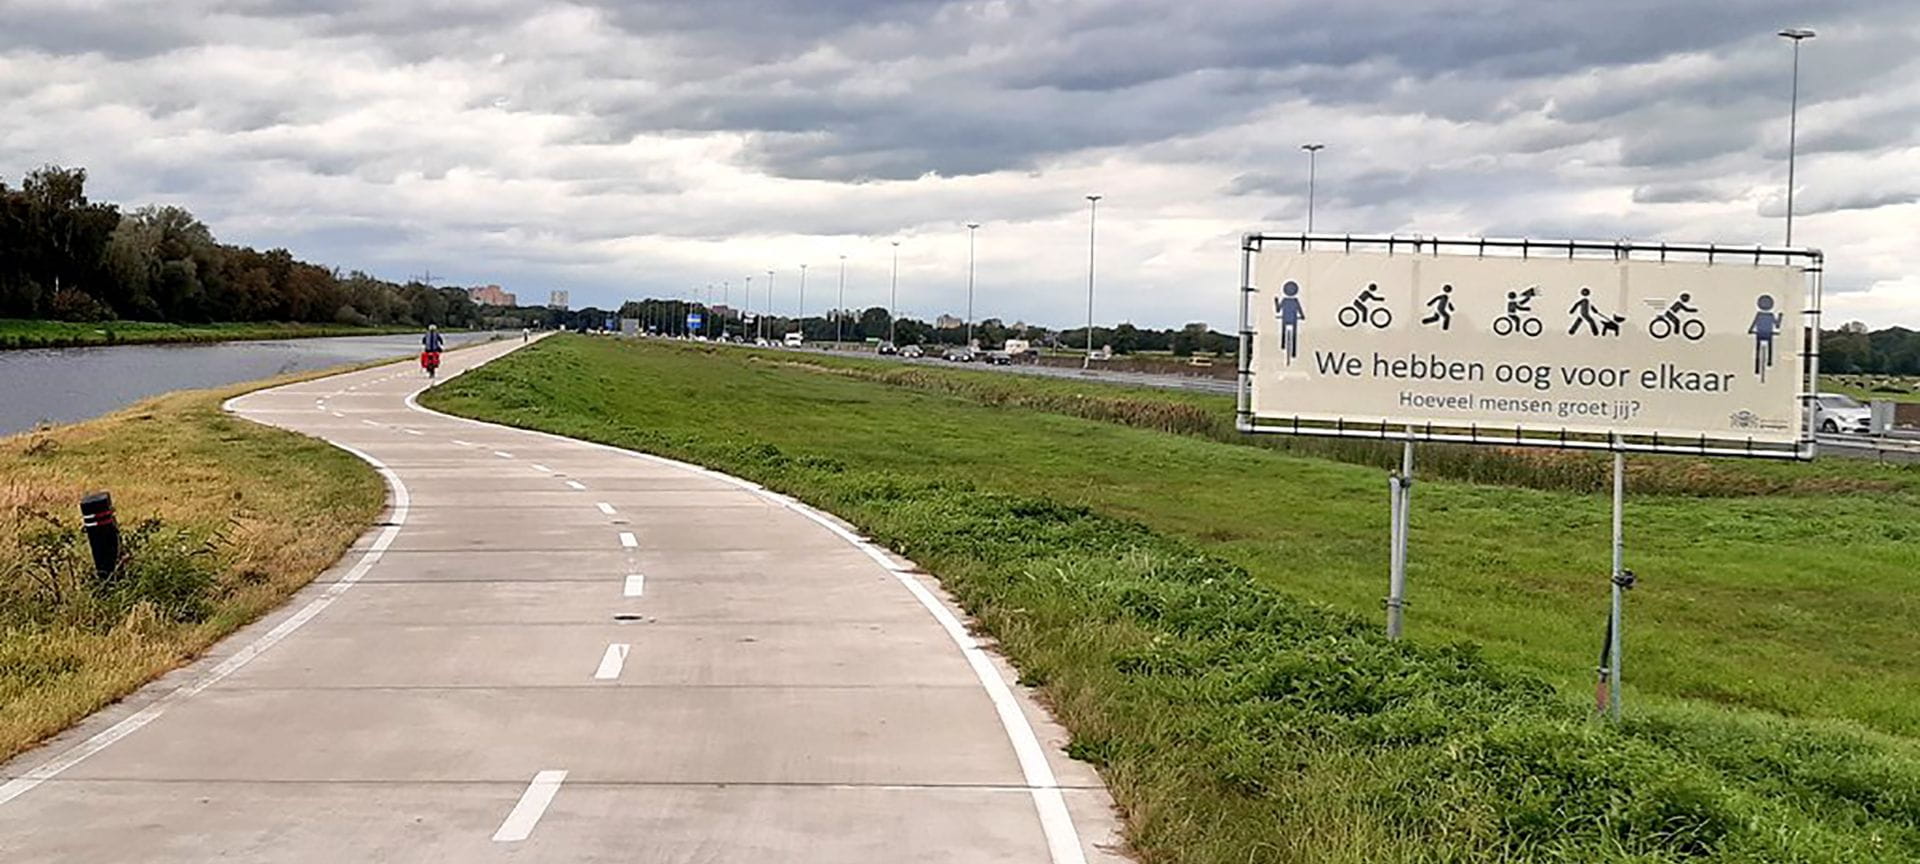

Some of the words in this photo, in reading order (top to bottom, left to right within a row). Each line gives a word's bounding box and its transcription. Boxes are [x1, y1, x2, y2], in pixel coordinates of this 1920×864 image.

[1315, 350, 1363, 377] We
[1373, 351, 1484, 382] hebben
[1495, 364, 1552, 391] oog
[1560, 366, 1631, 388] voor
[1640, 363, 1736, 393] elkaar
[1399, 391, 1473, 409] Hoeveel
[1479, 398, 1552, 413] mensen
[1557, 401, 1608, 418] groet
[1612, 400, 1641, 420] jij?
